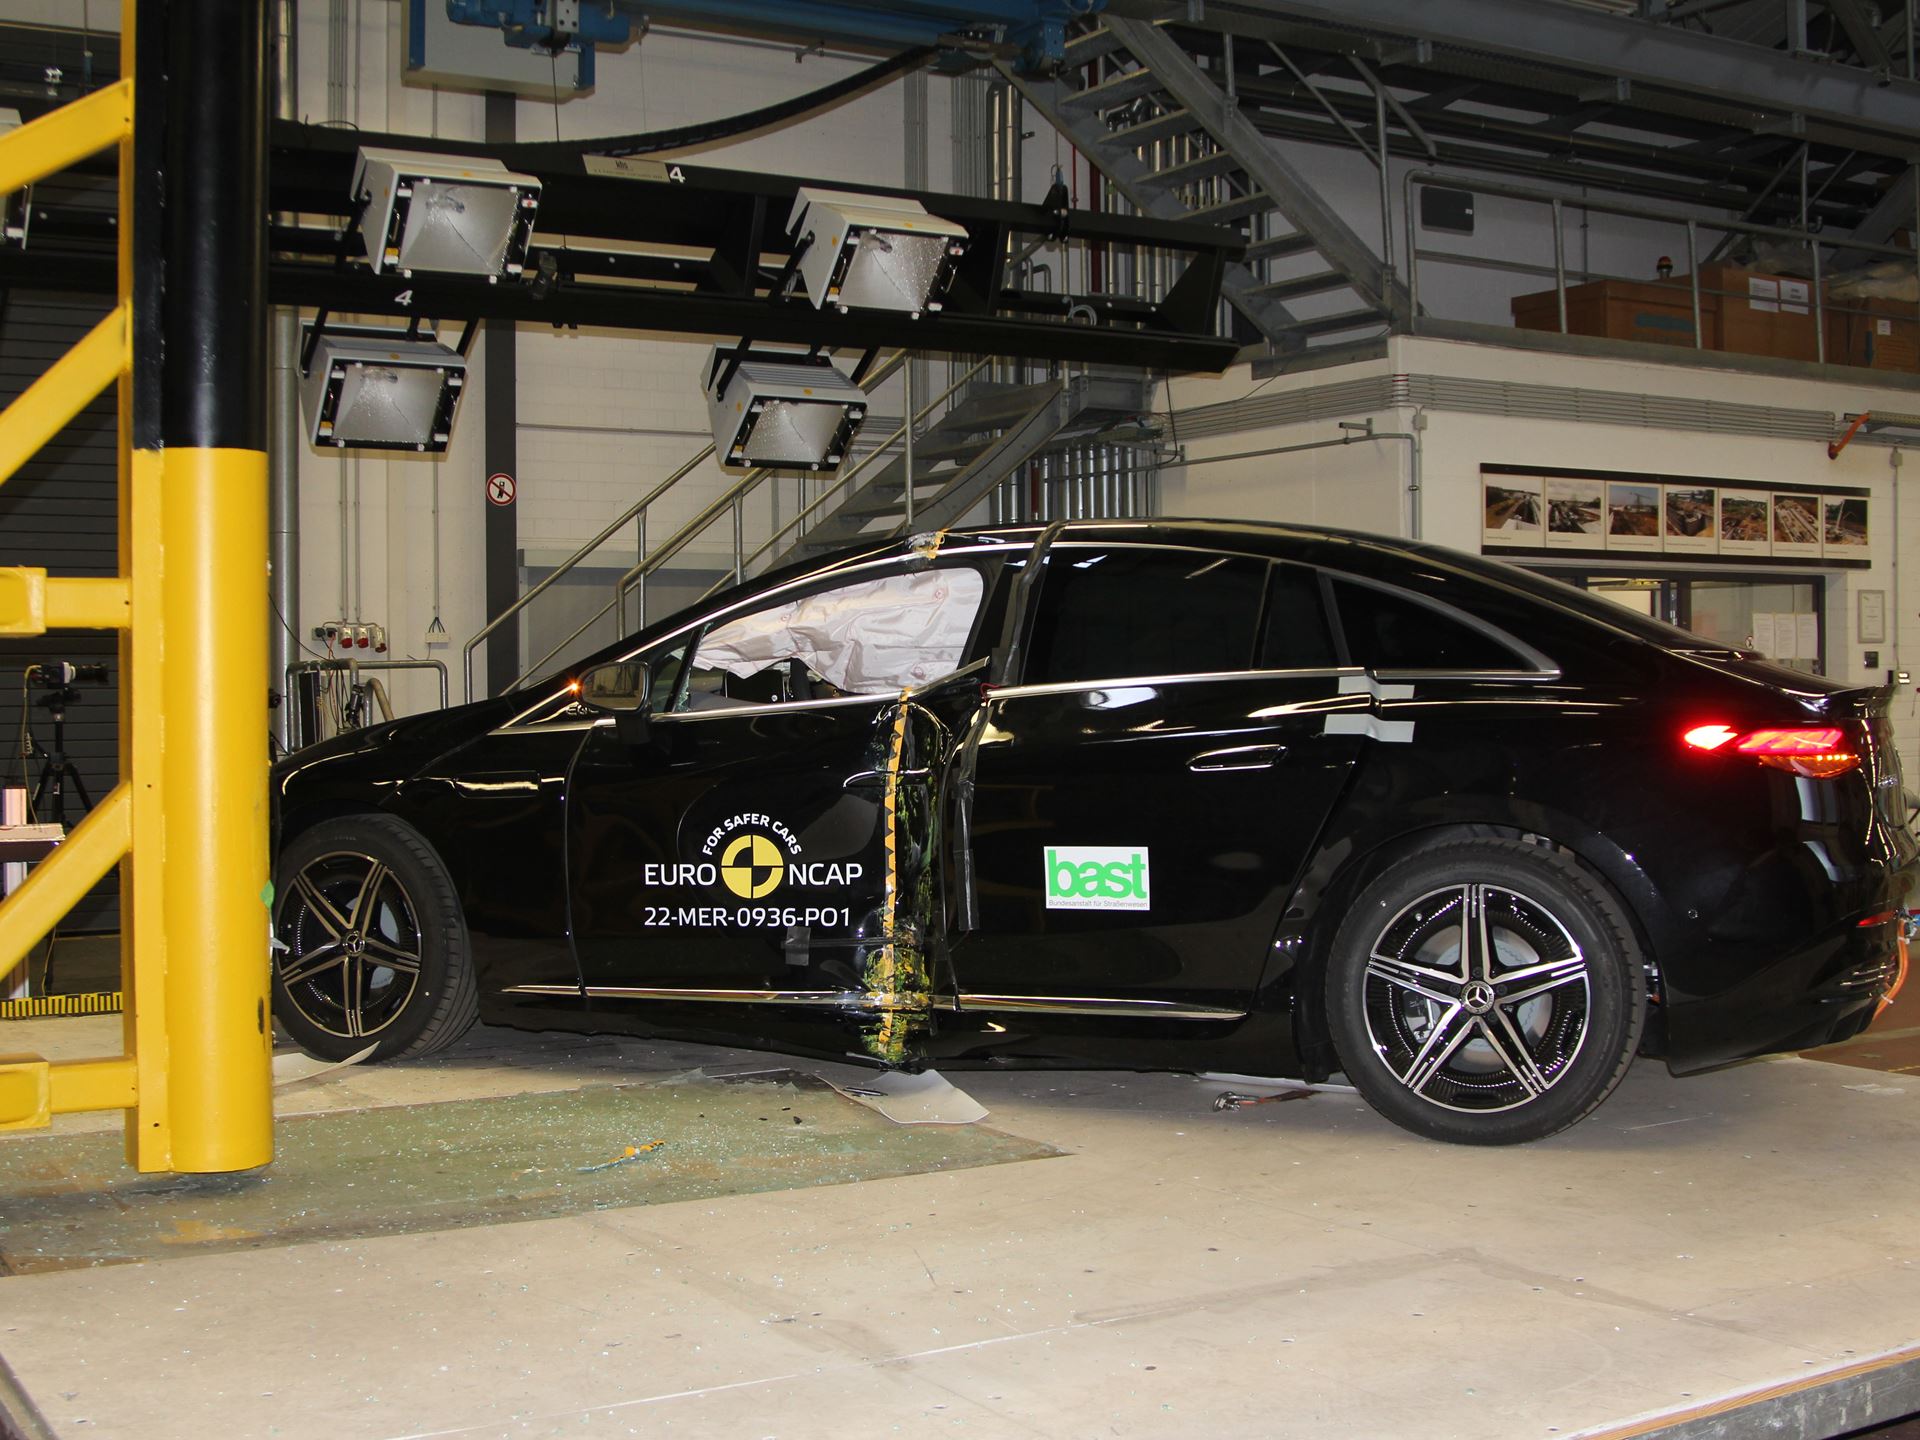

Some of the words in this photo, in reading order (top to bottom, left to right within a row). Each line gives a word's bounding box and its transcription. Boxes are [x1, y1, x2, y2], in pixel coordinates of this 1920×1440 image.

[669, 166, 686, 184] 4
[394, 289, 413, 306] 4
[702, 826, 726, 856] FOR
[723, 813, 771, 832] SAFER
[771, 820, 803, 855] CARS
[644, 863, 717, 886] EURO
[789, 863, 863, 886] NCAP
[1047, 849, 1148, 899] bast
[1048, 899, 1093, 907] Bundesanstalt
